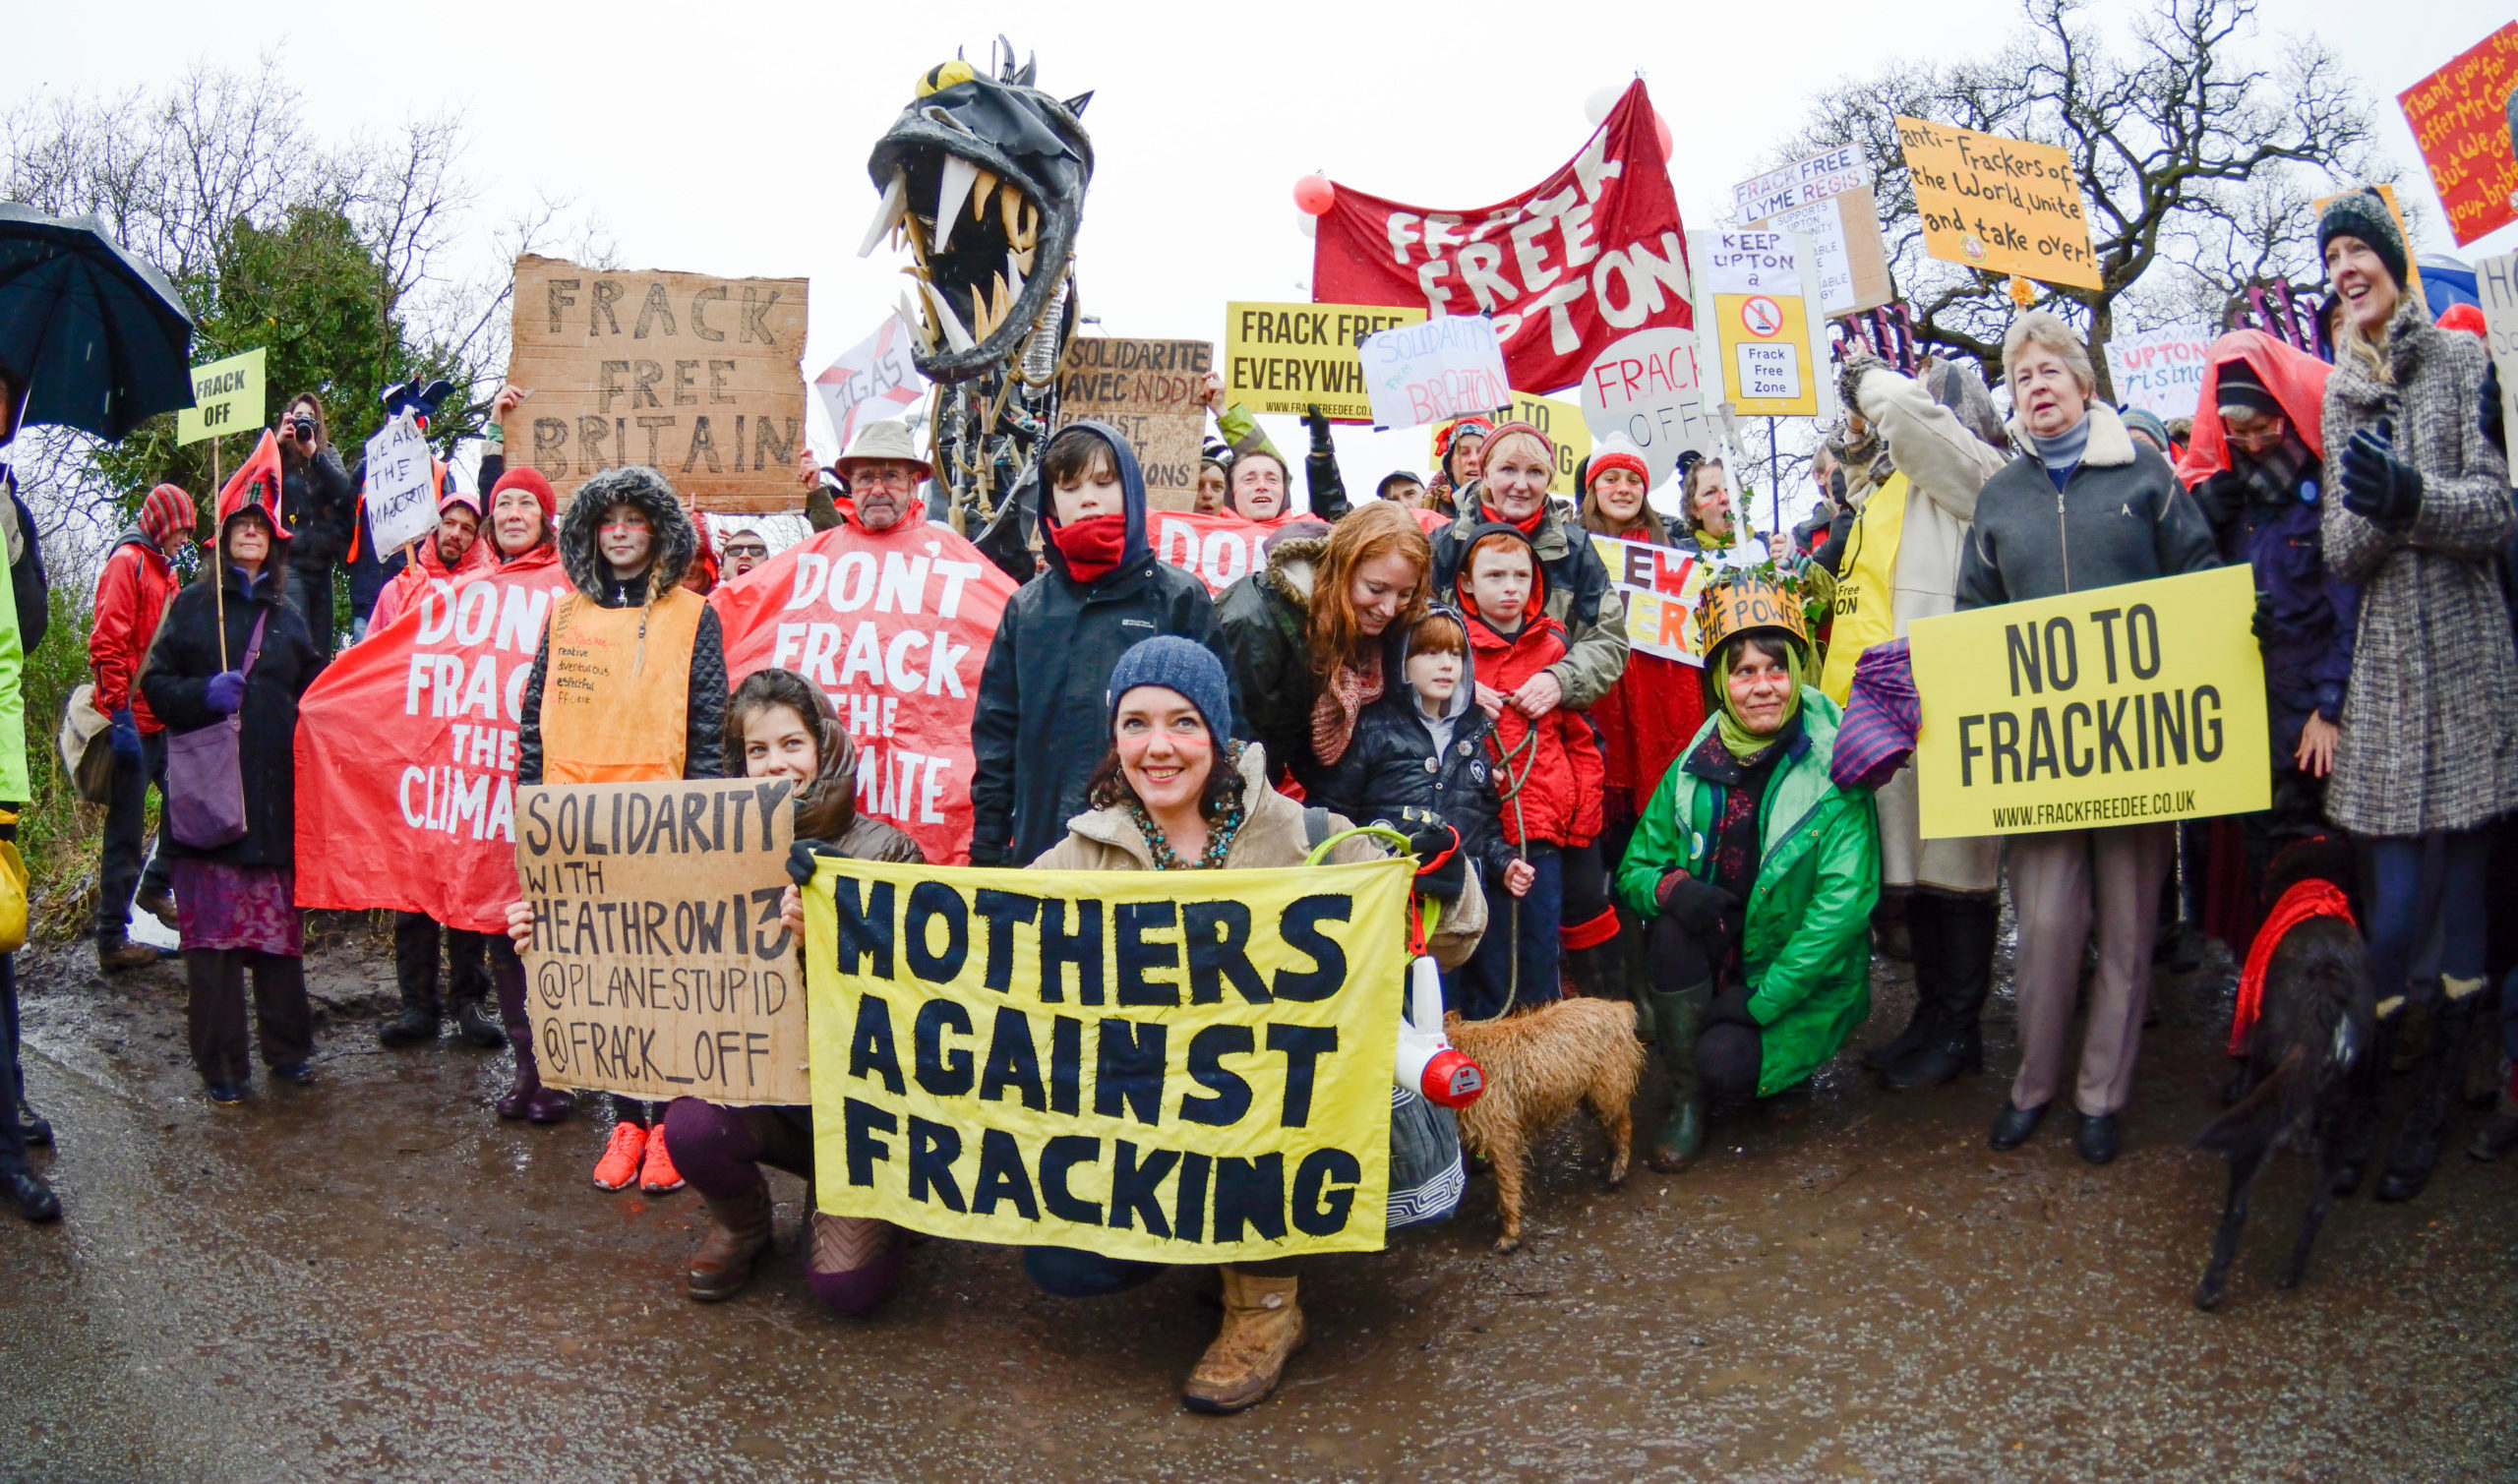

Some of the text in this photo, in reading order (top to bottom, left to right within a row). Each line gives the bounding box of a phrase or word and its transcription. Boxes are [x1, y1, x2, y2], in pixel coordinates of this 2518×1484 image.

[2404, 71, 2454, 120] Thank
[2455, 56, 2481, 96] you
[2482, 56, 2505, 85] for
[2419, 110, 2457, 150] offer
[2456, 97, 2487, 127] Mr
[1736, 149, 1851, 204] FRACK FREE
[1900, 126, 2072, 193] anti-Frackers of
[1912, 166, 1947, 190] the
[2429, 152, 2469, 197] But
[2458, 132, 2489, 159] We
[1746, 170, 1861, 222] LYME REGIS
[1777, 203, 1829, 226] SUPPORTS
[2447, 199, 2487, 234] your
[1417, 204, 1599, 321] FREE
[1713, 254, 1794, 269] UPTON
[1722, 234, 1780, 251] KEEP
[1925, 208, 1966, 232] and
[1975, 217, 2028, 251] take
[2038, 236, 2093, 268] over!
[549, 278, 782, 344] FRACK
[1241, 311, 1329, 346] FRACK
[1067, 338, 1210, 374] SOLIDARITE
[1377, 318, 1494, 364] SOLIDARITY
[1749, 348, 1785, 360] Frack
[2125, 341, 2209, 370] UPTON
[197, 370, 246, 400] FRACK
[599, 360, 737, 413] FREE
[1062, 372, 1207, 406] AVEC NDDL
[1754, 381, 1786, 392] Zone
[1755, 365, 1783, 376] Free
[204, 402, 231, 428] OFF
[369, 440, 389, 466] WE
[371, 458, 411, 490] THE
[534, 415, 799, 482] BRITAIN
[783, 541, 983, 619] DON'T
[1701, 599, 1805, 649] THE POWER
[2005, 603, 2161, 697] NO TO
[770, 622, 971, 699] FRACK
[406, 653, 534, 726] FRAC
[830, 693, 899, 738] THE
[450, 724, 517, 772] THE
[1958, 684, 2224, 788] FRACKING
[399, 764, 516, 843] CLIMA
[526, 782, 792, 856] SOLIDARITY
[1993, 790, 2195, 828] WWW.FRACKFREEDEE.CO.UK
[525, 861, 604, 895] WITH
[834, 874, 1353, 1007] MOTHERS
[538, 960, 787, 1016] @PLANESTUPID
[543, 1017, 769, 1087] @FRACK_OFF
[848, 992, 1339, 1128] AGAINST
[844, 1096, 1362, 1245] FRACKING
